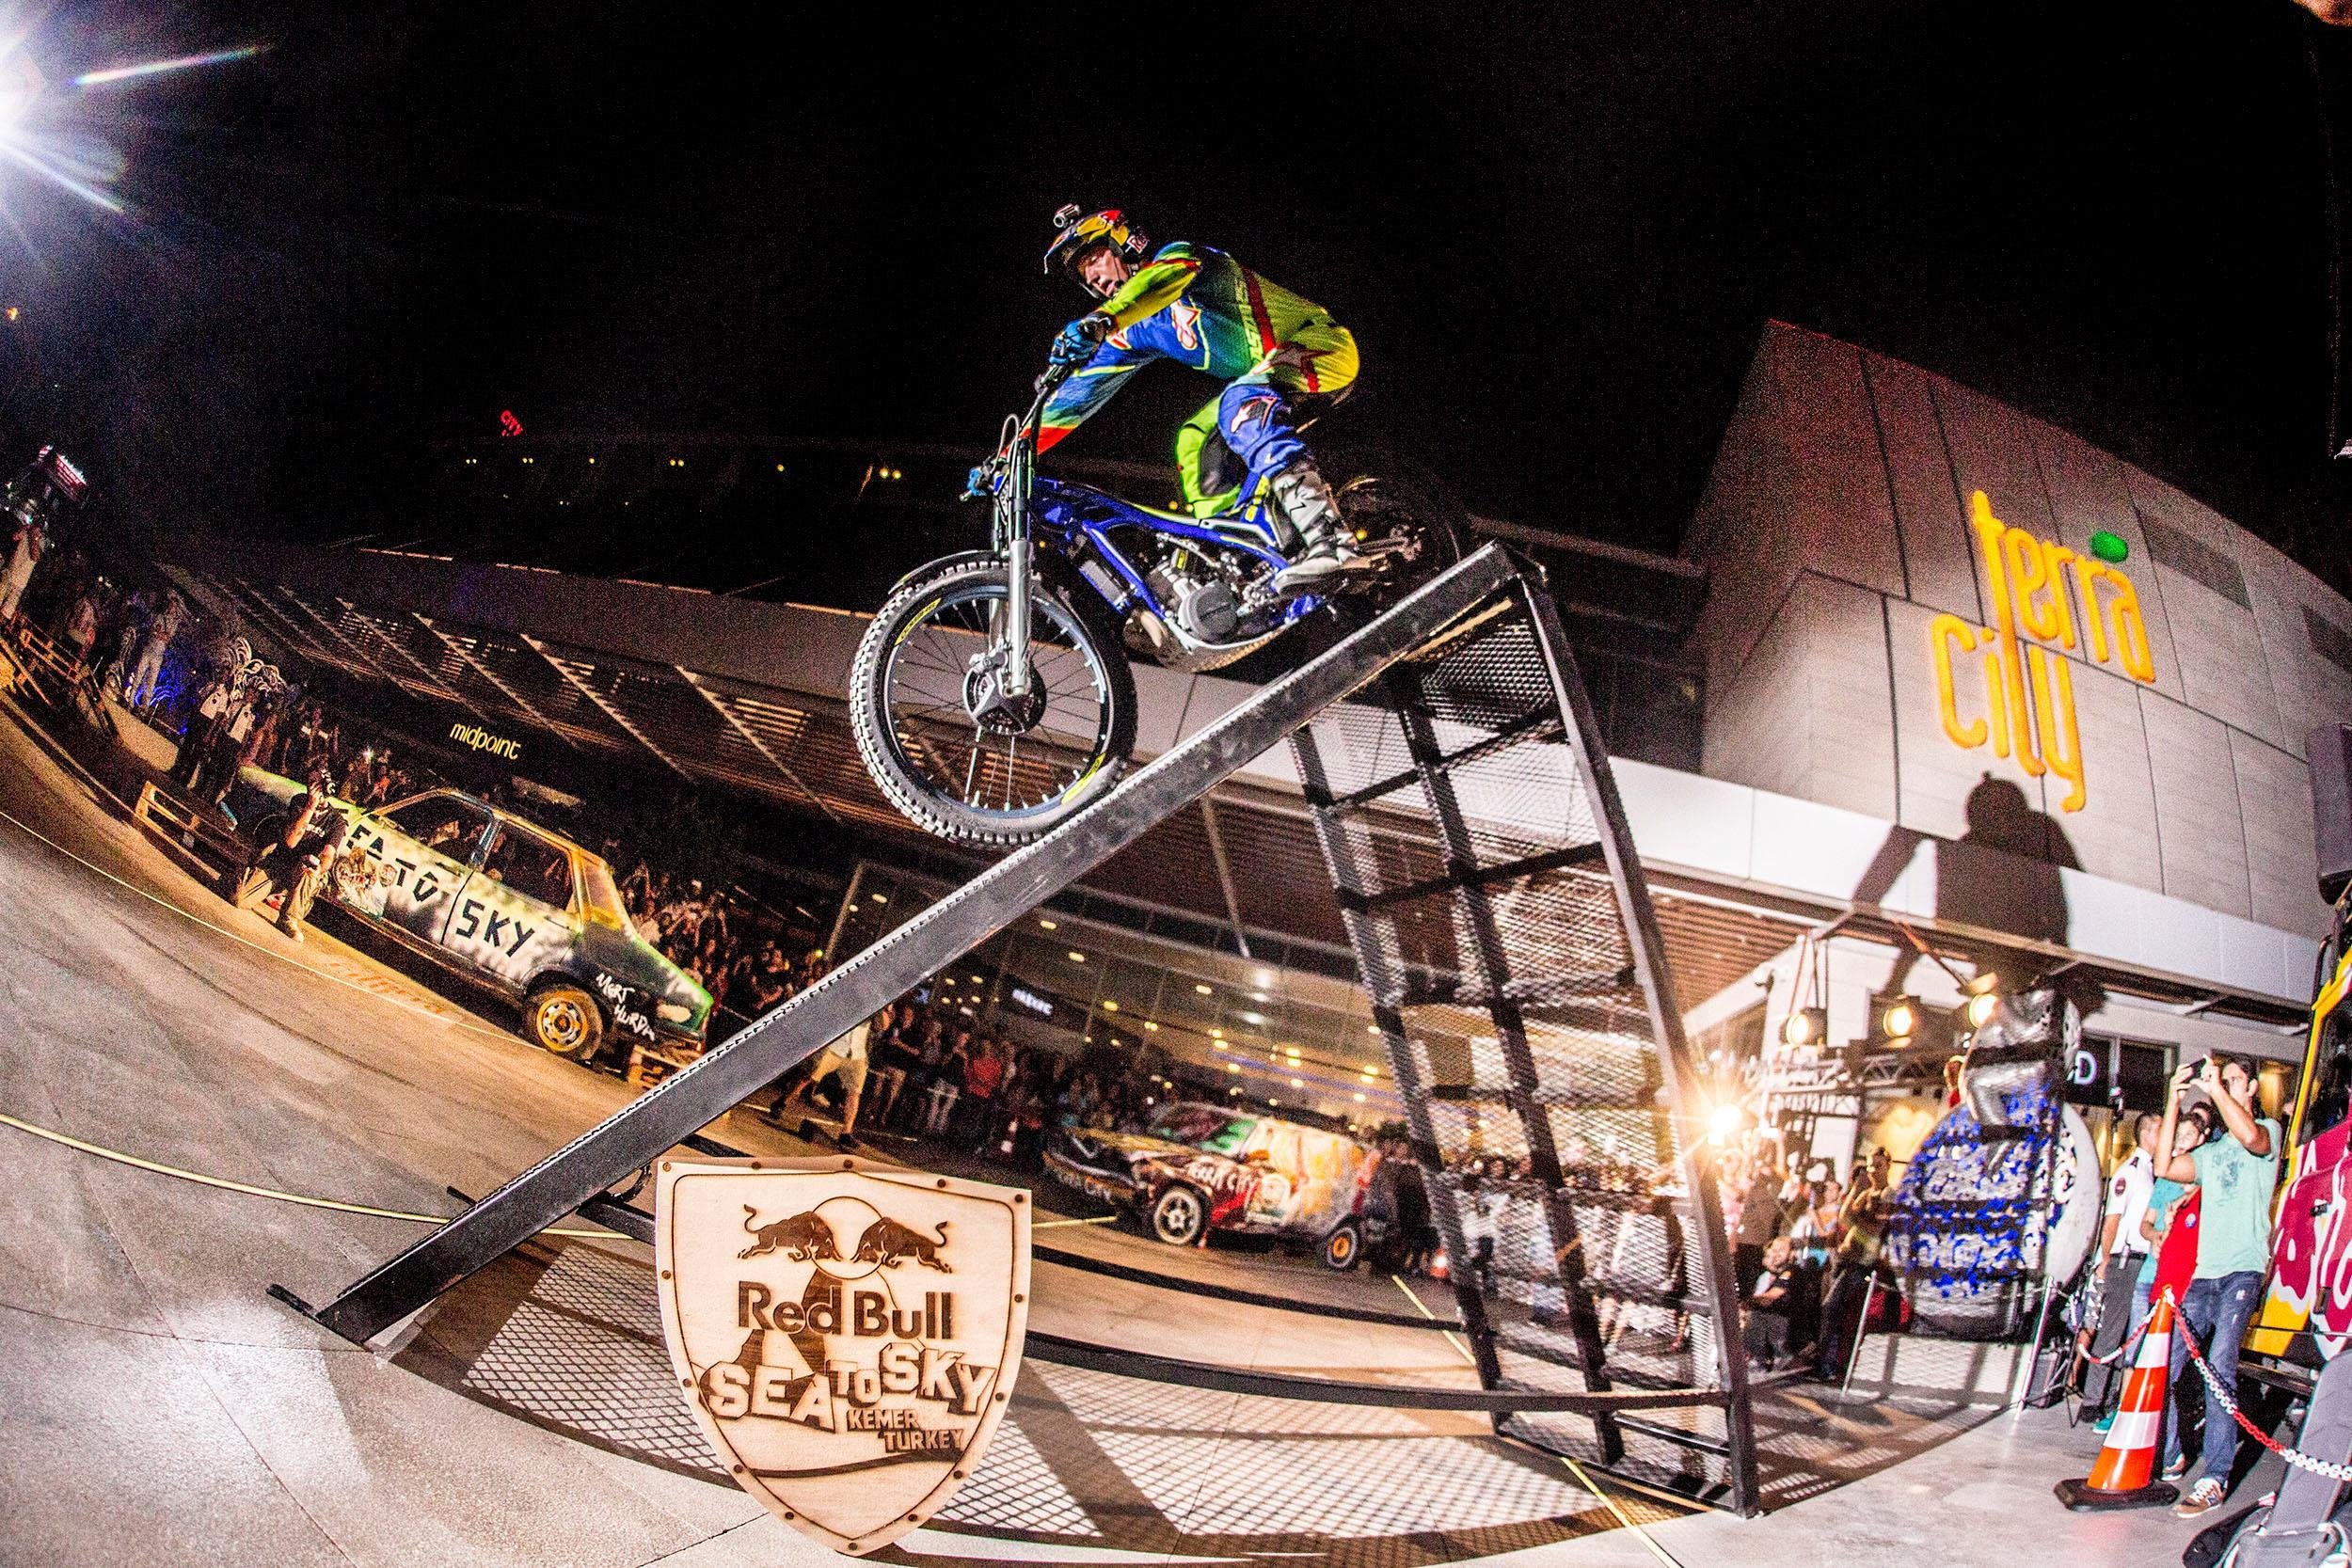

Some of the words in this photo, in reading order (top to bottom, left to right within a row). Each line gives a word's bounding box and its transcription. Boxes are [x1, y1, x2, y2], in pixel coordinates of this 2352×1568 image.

[1971, 489, 2156, 687] terra
[449, 722, 522, 760] midpoint
[1931, 613, 2087, 813] city
[455, 898, 535, 958] SKY
[739, 1280, 842, 1336] Red
[853, 1290, 952, 1340] Bull
[700, 1361, 837, 1433] SEA
[879, 1342, 997, 1416] SKY
[846, 1408, 920, 1432] KEMER
[881, 1428, 969, 1454] TURKEY
